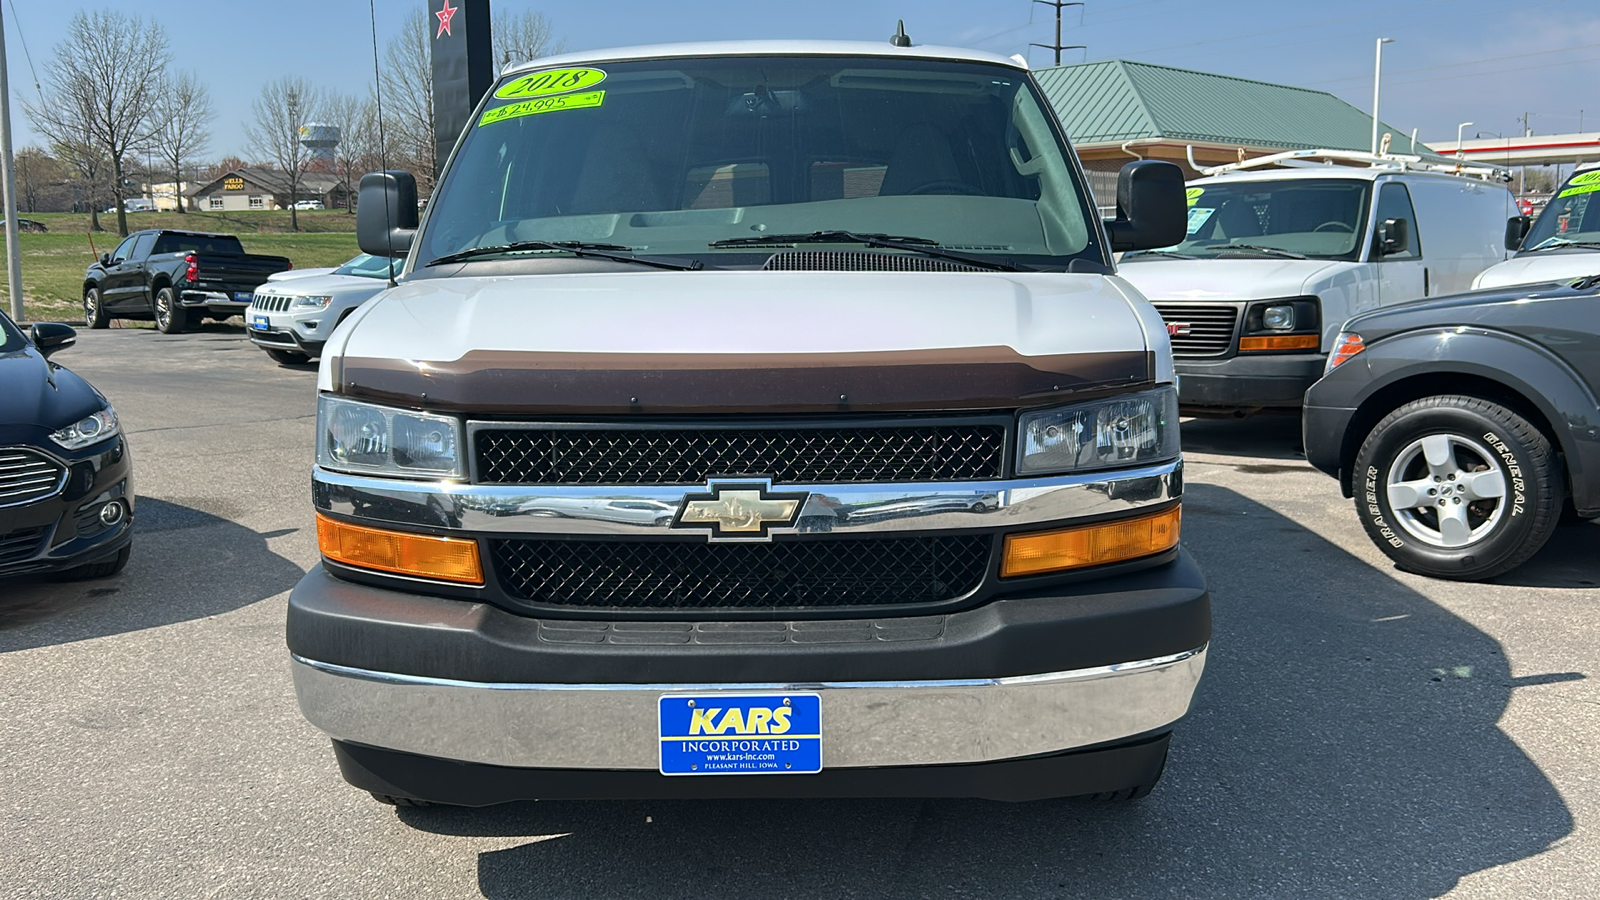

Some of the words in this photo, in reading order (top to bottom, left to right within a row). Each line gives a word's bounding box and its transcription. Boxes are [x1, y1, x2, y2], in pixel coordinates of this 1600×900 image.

[507, 70, 589, 96] 2018
[1483, 432, 1525, 516] GENERAL
[1365, 466, 1403, 548] GRABBER
[689, 707, 791, 734] KARS
[682, 740, 800, 752] INCORPORATED
